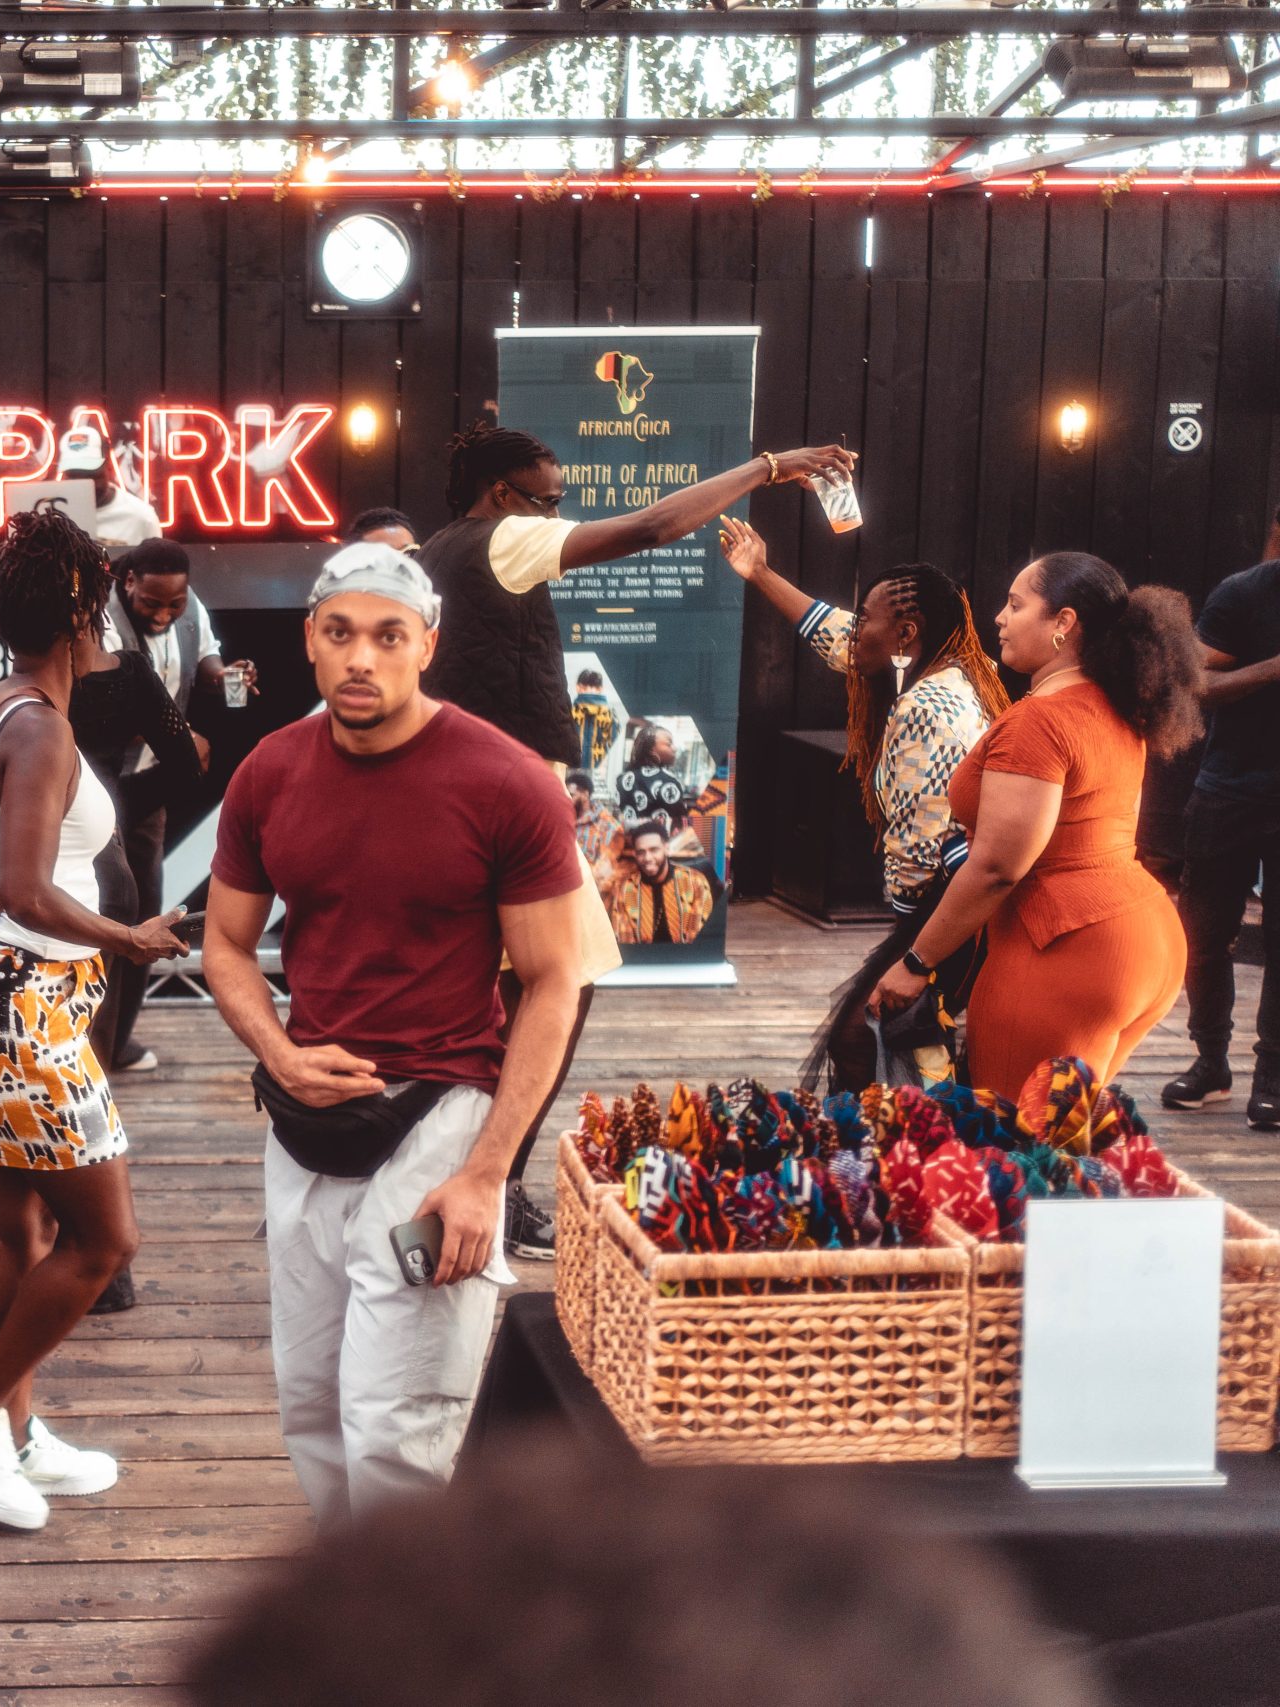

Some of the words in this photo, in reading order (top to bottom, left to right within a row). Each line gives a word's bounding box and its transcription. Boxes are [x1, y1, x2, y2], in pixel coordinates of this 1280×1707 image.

[578, 412, 670, 442] AFRICANCHICA
[562, 464, 611, 485] ARMTH
[620, 464, 637, 485] OF
[646, 463, 698, 484] AFRICA
[581, 486, 596, 507] IN
[605, 486, 616, 507] A
[624, 486, 661, 507] COAT
[566, 565, 595, 576] OGETHER
